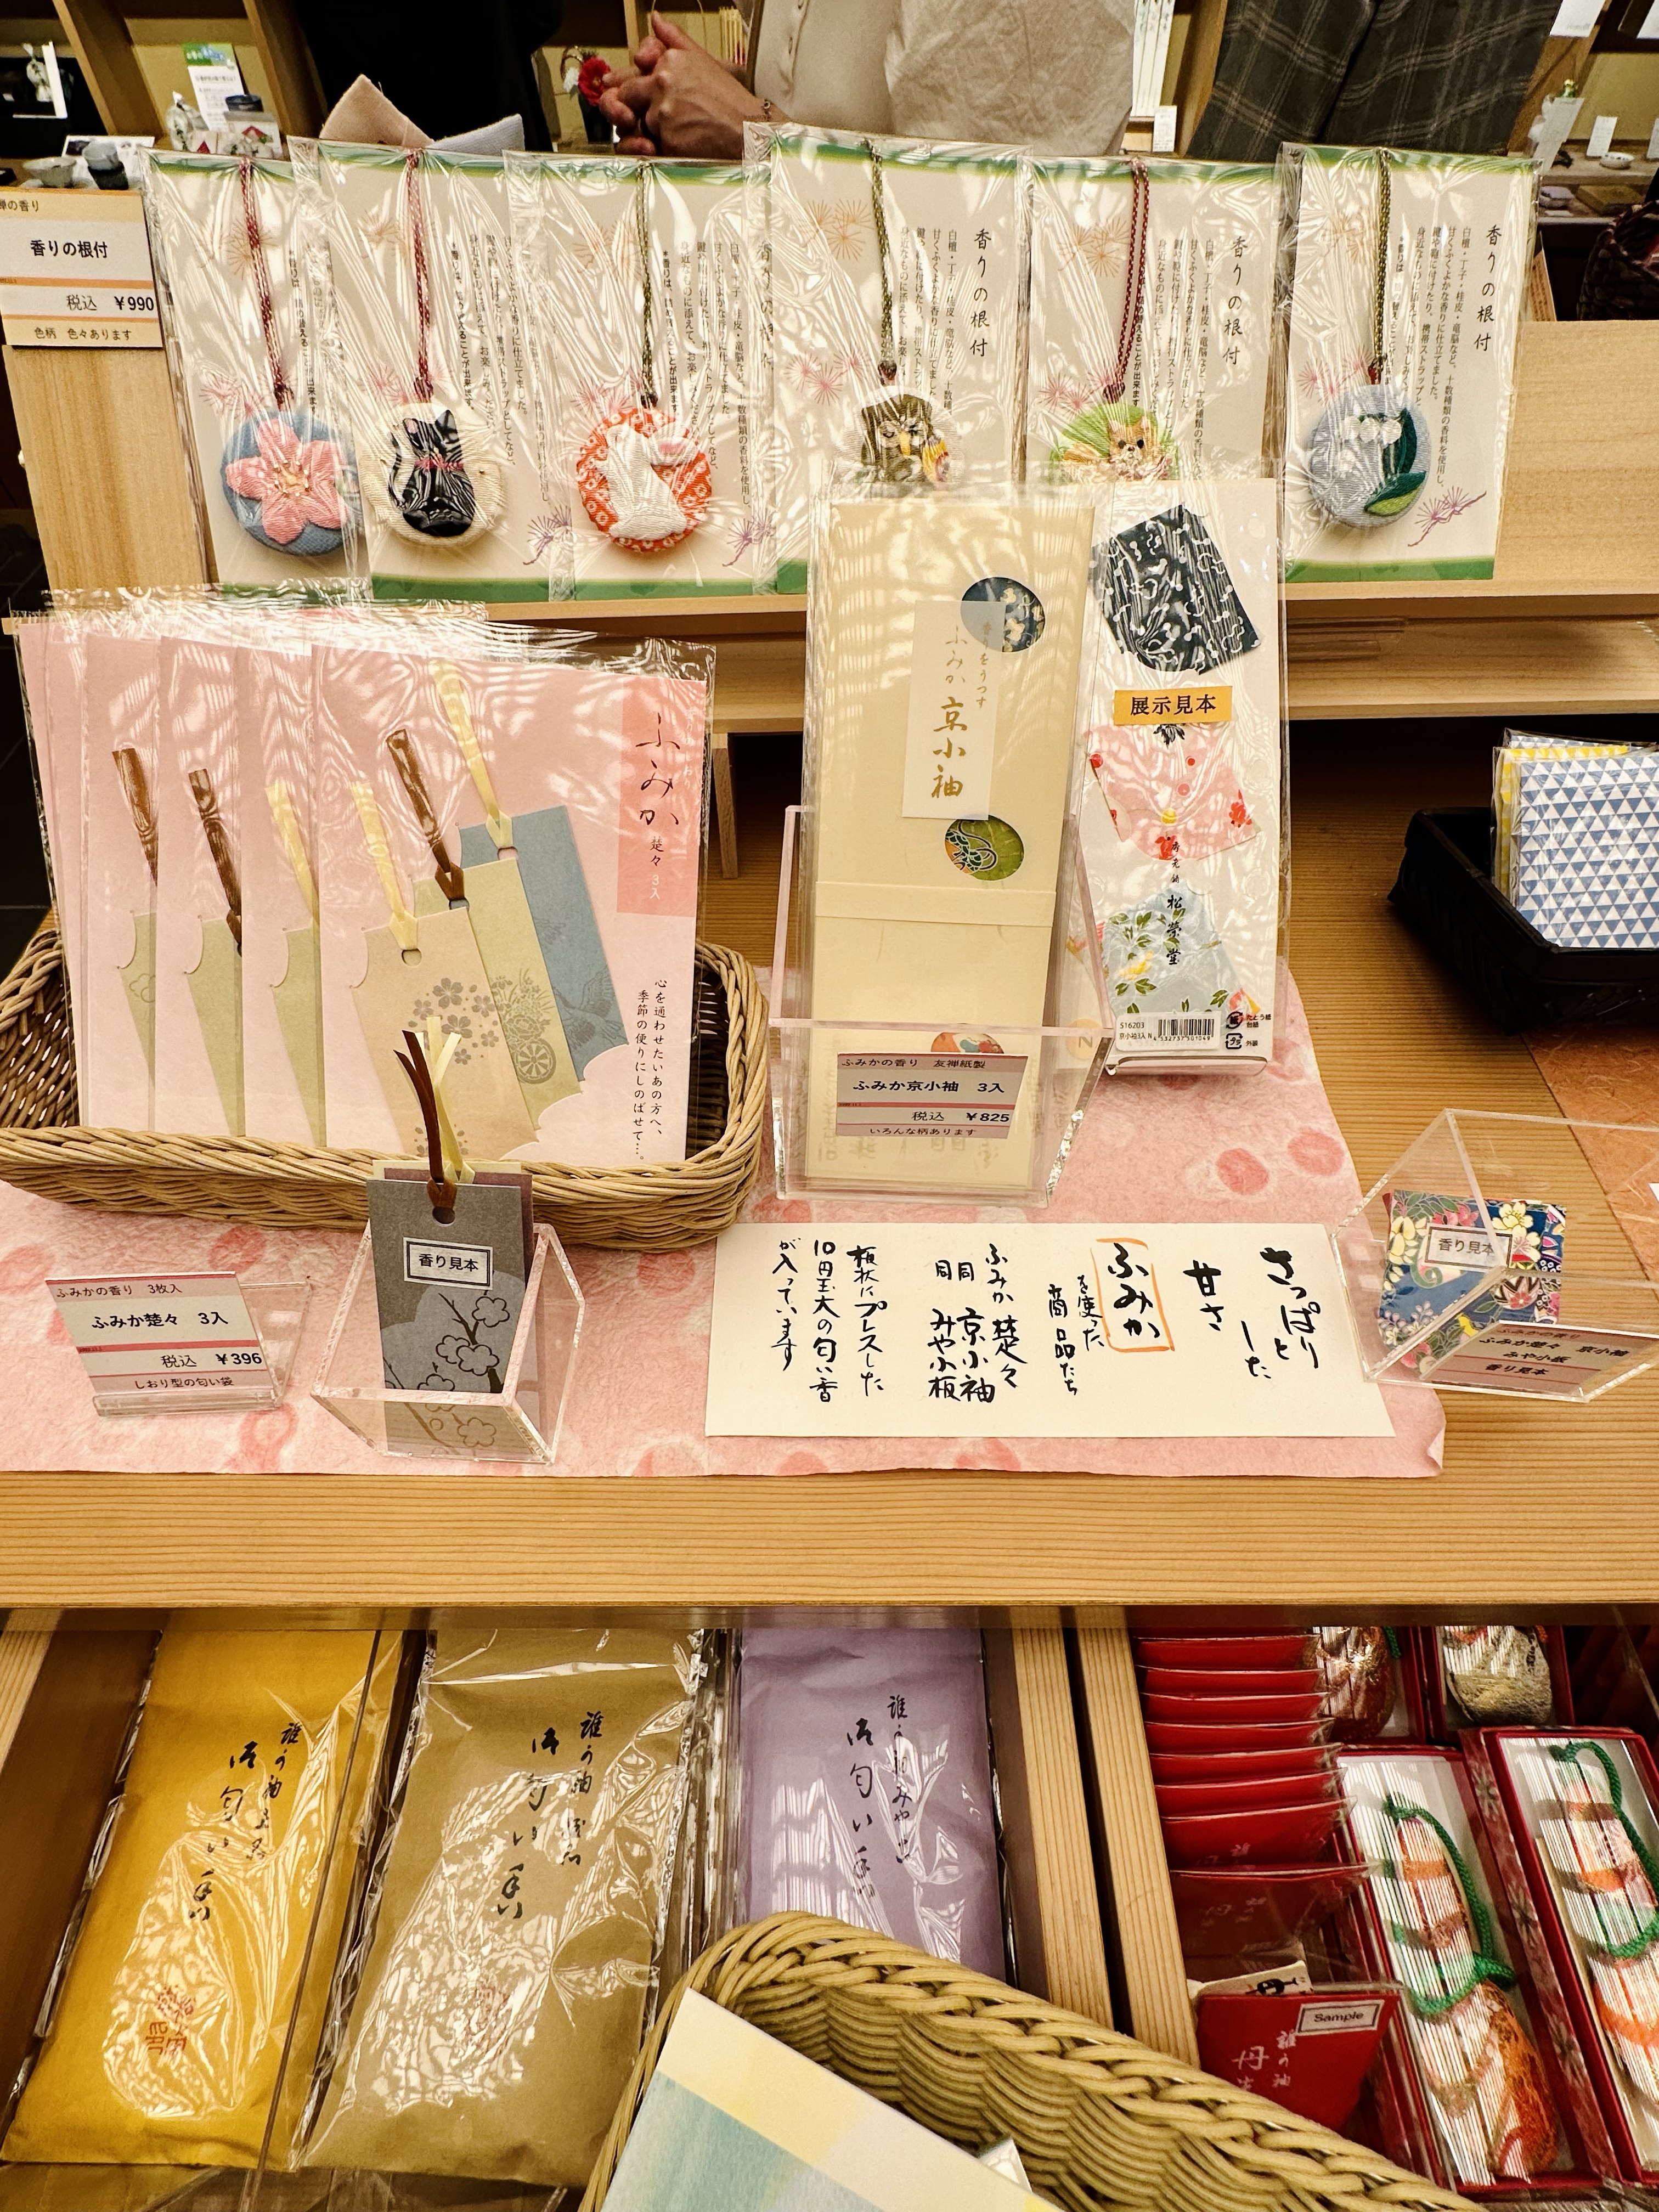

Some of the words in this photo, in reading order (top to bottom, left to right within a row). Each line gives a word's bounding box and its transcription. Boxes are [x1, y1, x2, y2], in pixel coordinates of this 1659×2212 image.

[30, 240, 108, 258] 香りの根付
[970, 228, 991, 357] 香りの根付
[1474, 224, 1502, 352] 香りの根付
[66, 295, 97, 311] 税込
[114, 296, 154, 311] ¥990
[1223, 236, 1248, 365] 香りの根付
[35, 328, 57, 339] 色柄
[67, 328, 132, 341] 色々あります
[945, 625, 967, 684] ふみか
[1130, 694, 1216, 716] 展示見本
[931, 696, 968, 798] 京小袖
[635, 712, 680, 825] ふみか
[1230, 1037, 1240, 1045] プラ
[650, 979, 667, 1135] 心を通わせたいあの方へ、
[842, 1059, 918, 1068] ふみかの香り
[933, 1060, 985, 1069] 友禅紙製
[853, 1080, 960, 1092] ふみか京小袖
[977, 1083, 1005, 1093] 3入
[911, 1111, 945, 1121] 税込
[966, 1112, 1010, 1122] ¥825
[870, 1128, 977, 1136] いろんな柄あります
[1438, 1238, 1494, 1256] 香り見本
[419, 1254, 479, 1272] 香り見本
[57, 1284, 133, 1298] ふみかの香り
[147, 1283, 183, 1294] 3枚入
[1108, 1243, 1161, 1339] ふみか
[1183, 1260, 1224, 1331] 甘さ
[771, 1238, 801, 1371] が入っています
[1077, 1274, 1104, 1352] を使った
[91, 1312, 179, 1330] ふみか楚々
[198, 1311, 228, 1325] 3入
[809, 1240, 840, 1402] 10円玉大の匂い香
[847, 1245, 888, 1397] 板状にプレスした
[1048, 1284, 1077, 1395] 商品たち
[161, 1354, 197, 1368] 税込
[215, 1352, 262, 1365] ¥396
[135, 1377, 235, 1389] しおり型の匂い袋
[1314, 2011, 1364, 2023] Sample
